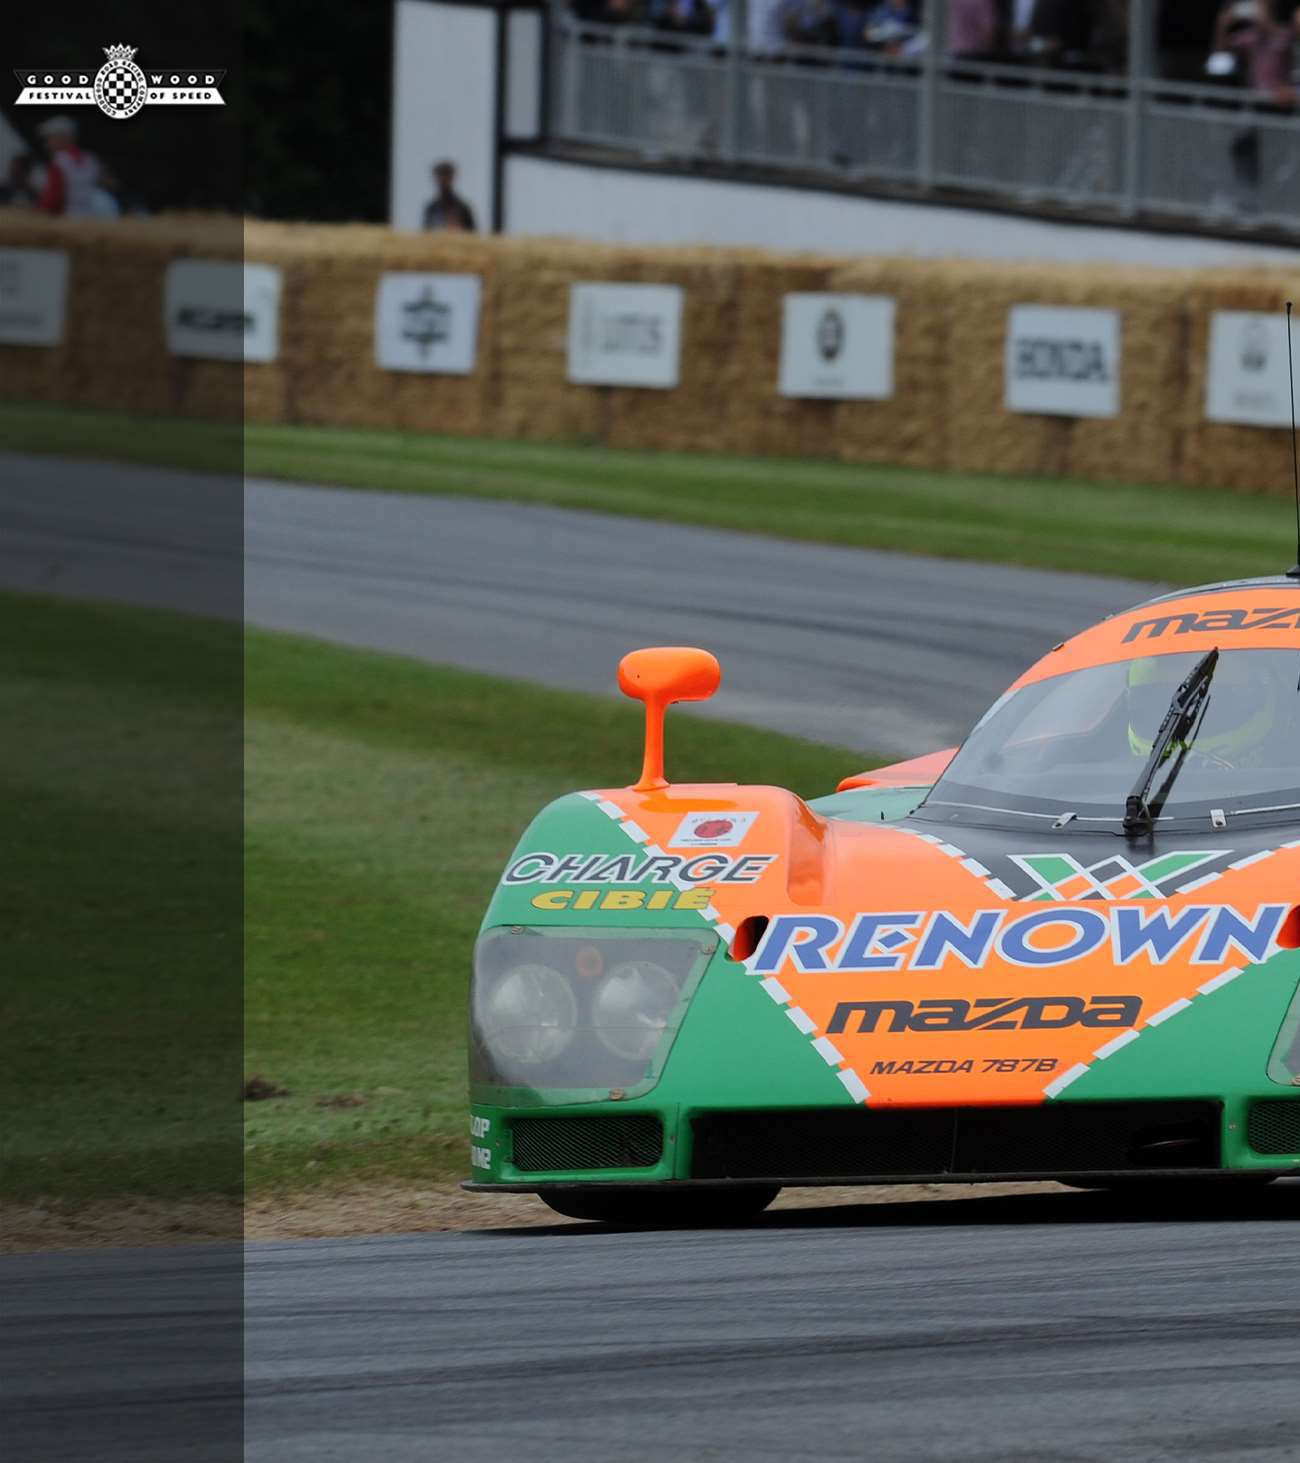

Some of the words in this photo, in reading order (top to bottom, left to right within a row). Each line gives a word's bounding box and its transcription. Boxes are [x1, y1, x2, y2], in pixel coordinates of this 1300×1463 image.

[501, 852, 779, 885] CHARGE
[531, 886, 717, 910] CIBIÉ
[746, 903, 1292, 975] RENOWN
[825, 995, 1144, 1035] mazda
[870, 1060, 974, 1076] MAZDA
[982, 1058, 1059, 1074] 787B
